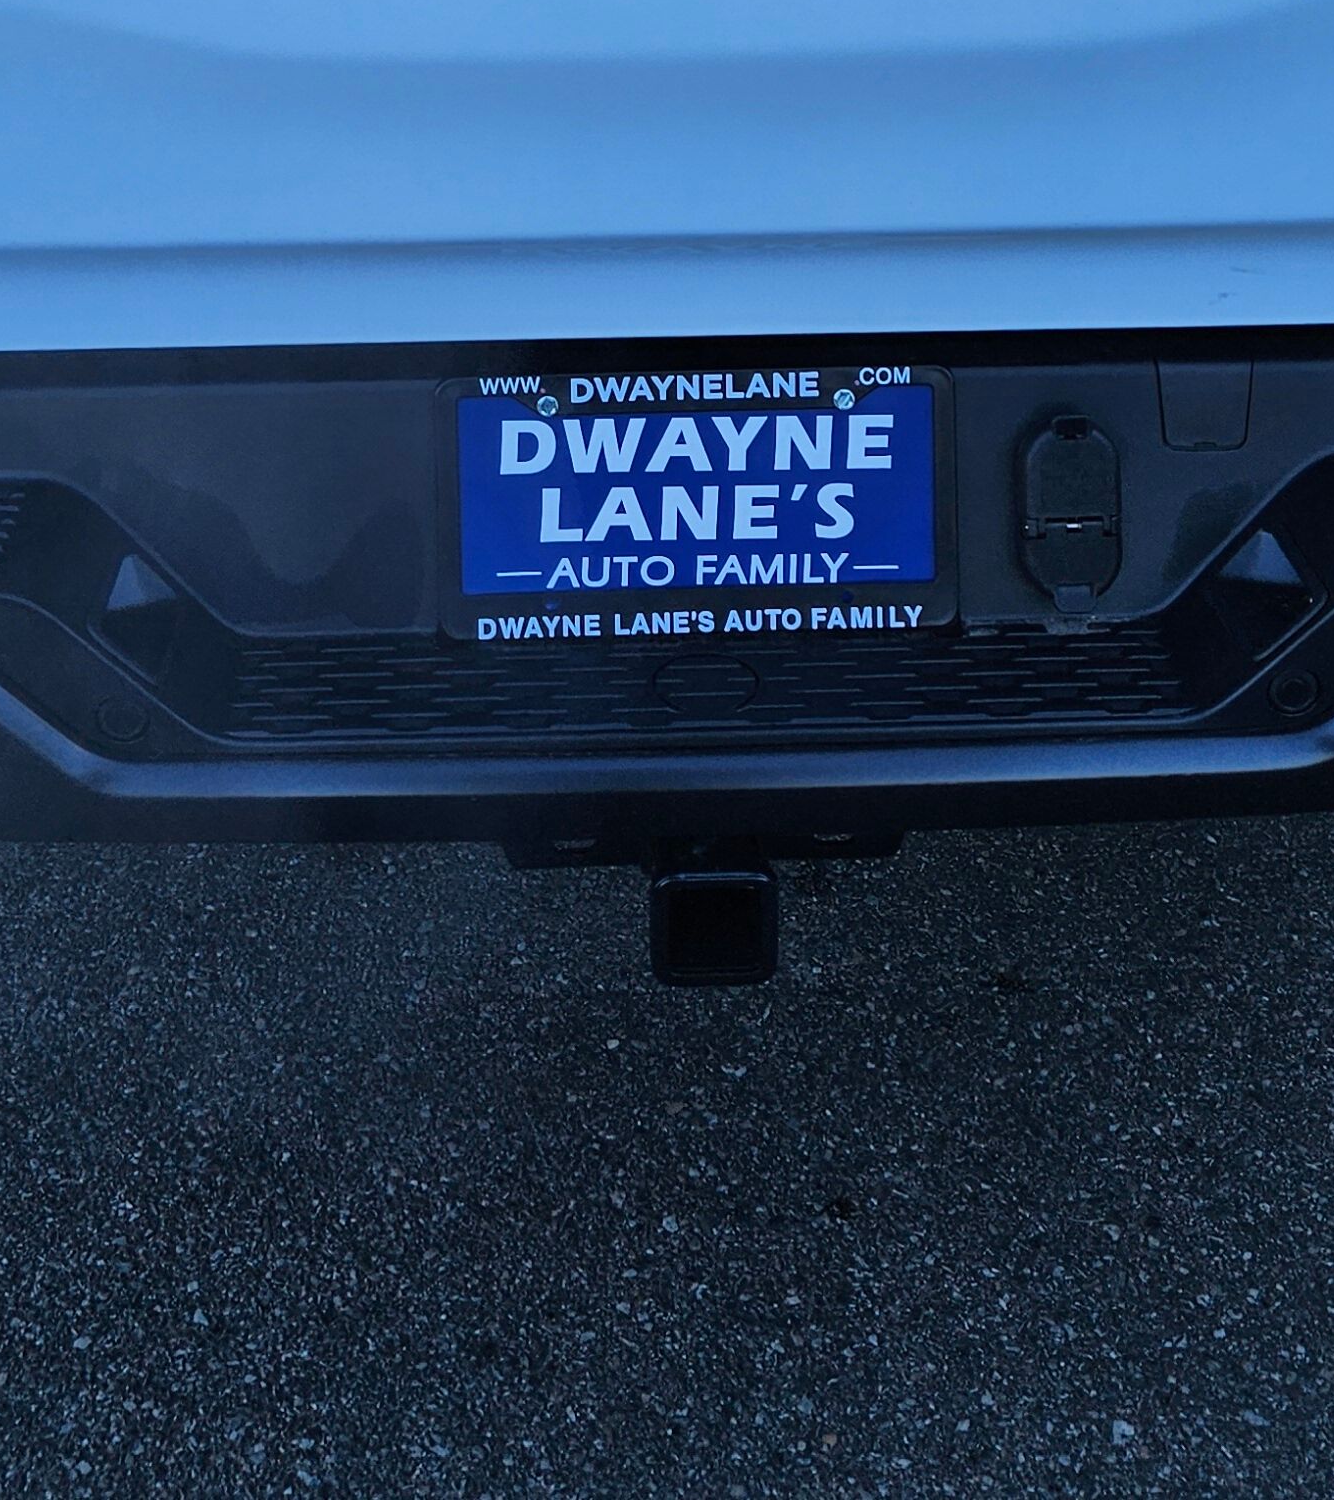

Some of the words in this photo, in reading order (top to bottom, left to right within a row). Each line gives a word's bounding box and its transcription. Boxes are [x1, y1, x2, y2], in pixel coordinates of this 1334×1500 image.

[569, 371, 820, 404] DWAYNELANE
[499, 414, 894, 476] DWAYNE
[540, 482, 855, 543] LANE'S
[546, 555, 675, 589] AUTO
[695, 552, 850, 586] FAMILY
[477, 613, 601, 640] DWAYNE
[614, 610, 715, 636] LANE'S
[723, 608, 802, 632] AUTO
[811, 605, 923, 630] FAMILY
